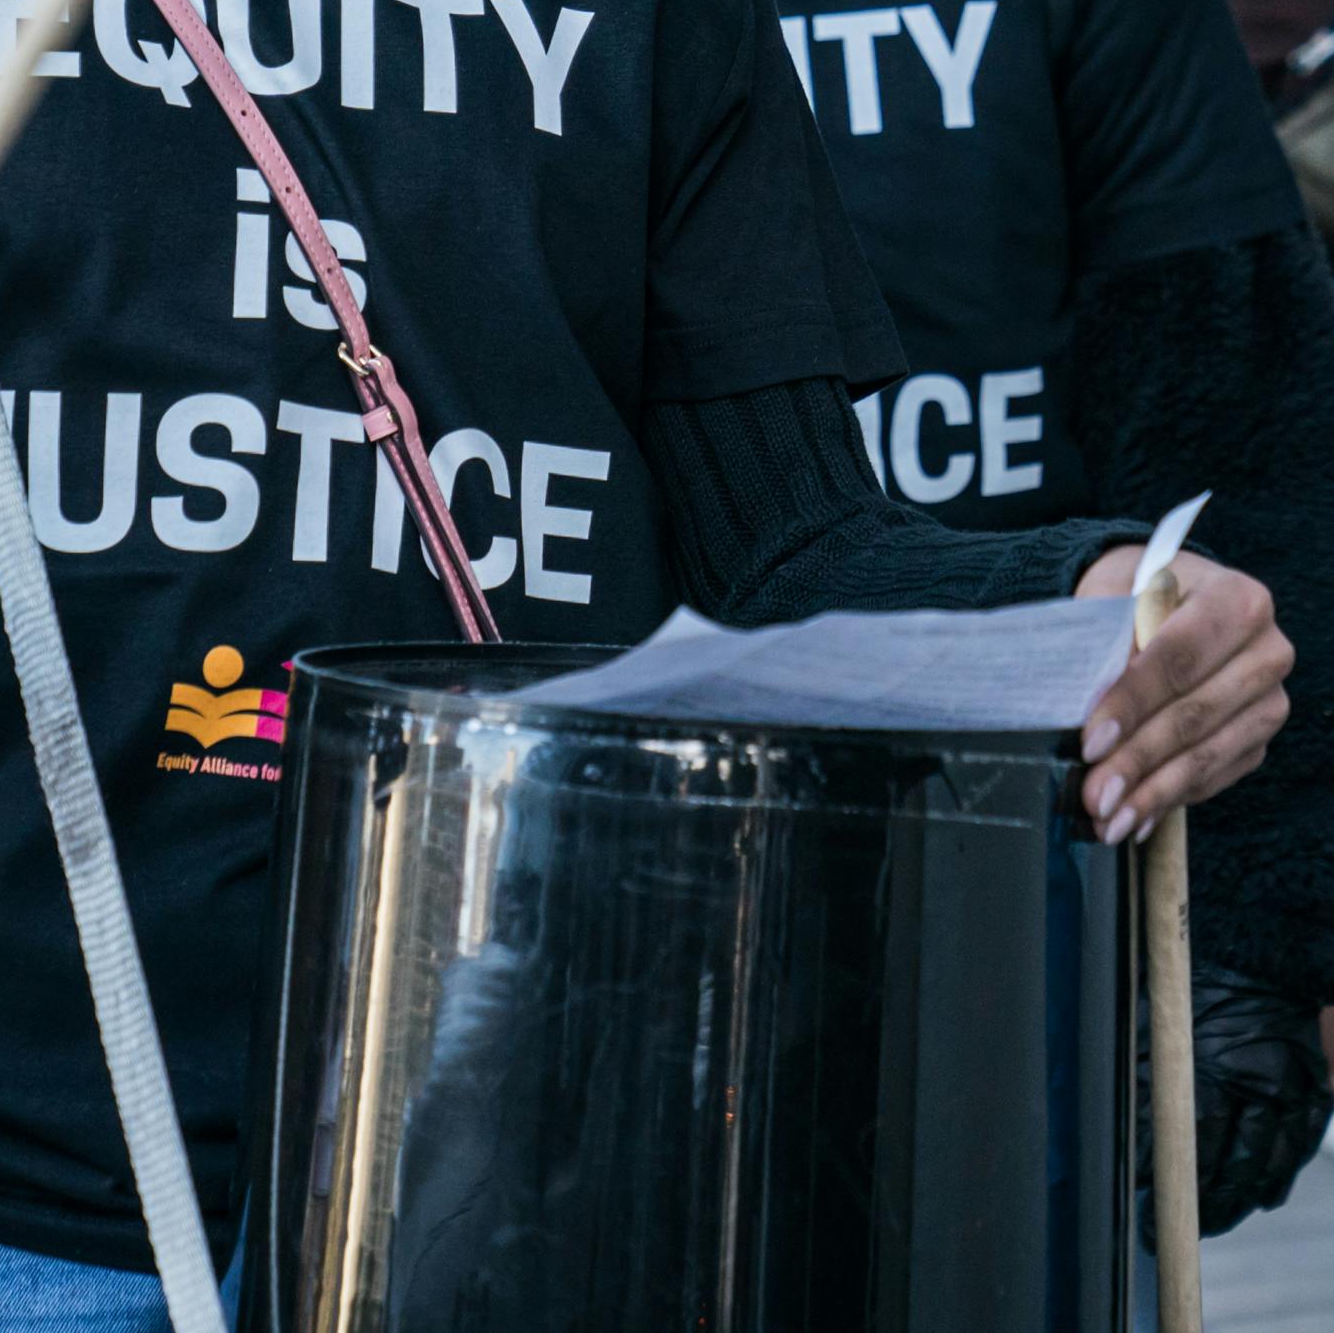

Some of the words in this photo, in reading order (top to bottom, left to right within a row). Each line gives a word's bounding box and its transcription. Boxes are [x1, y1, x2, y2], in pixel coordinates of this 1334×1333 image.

[233, 168, 368, 330] is
[157, 752, 199, 774] Equity
[200, 756, 258, 779] Alliance
